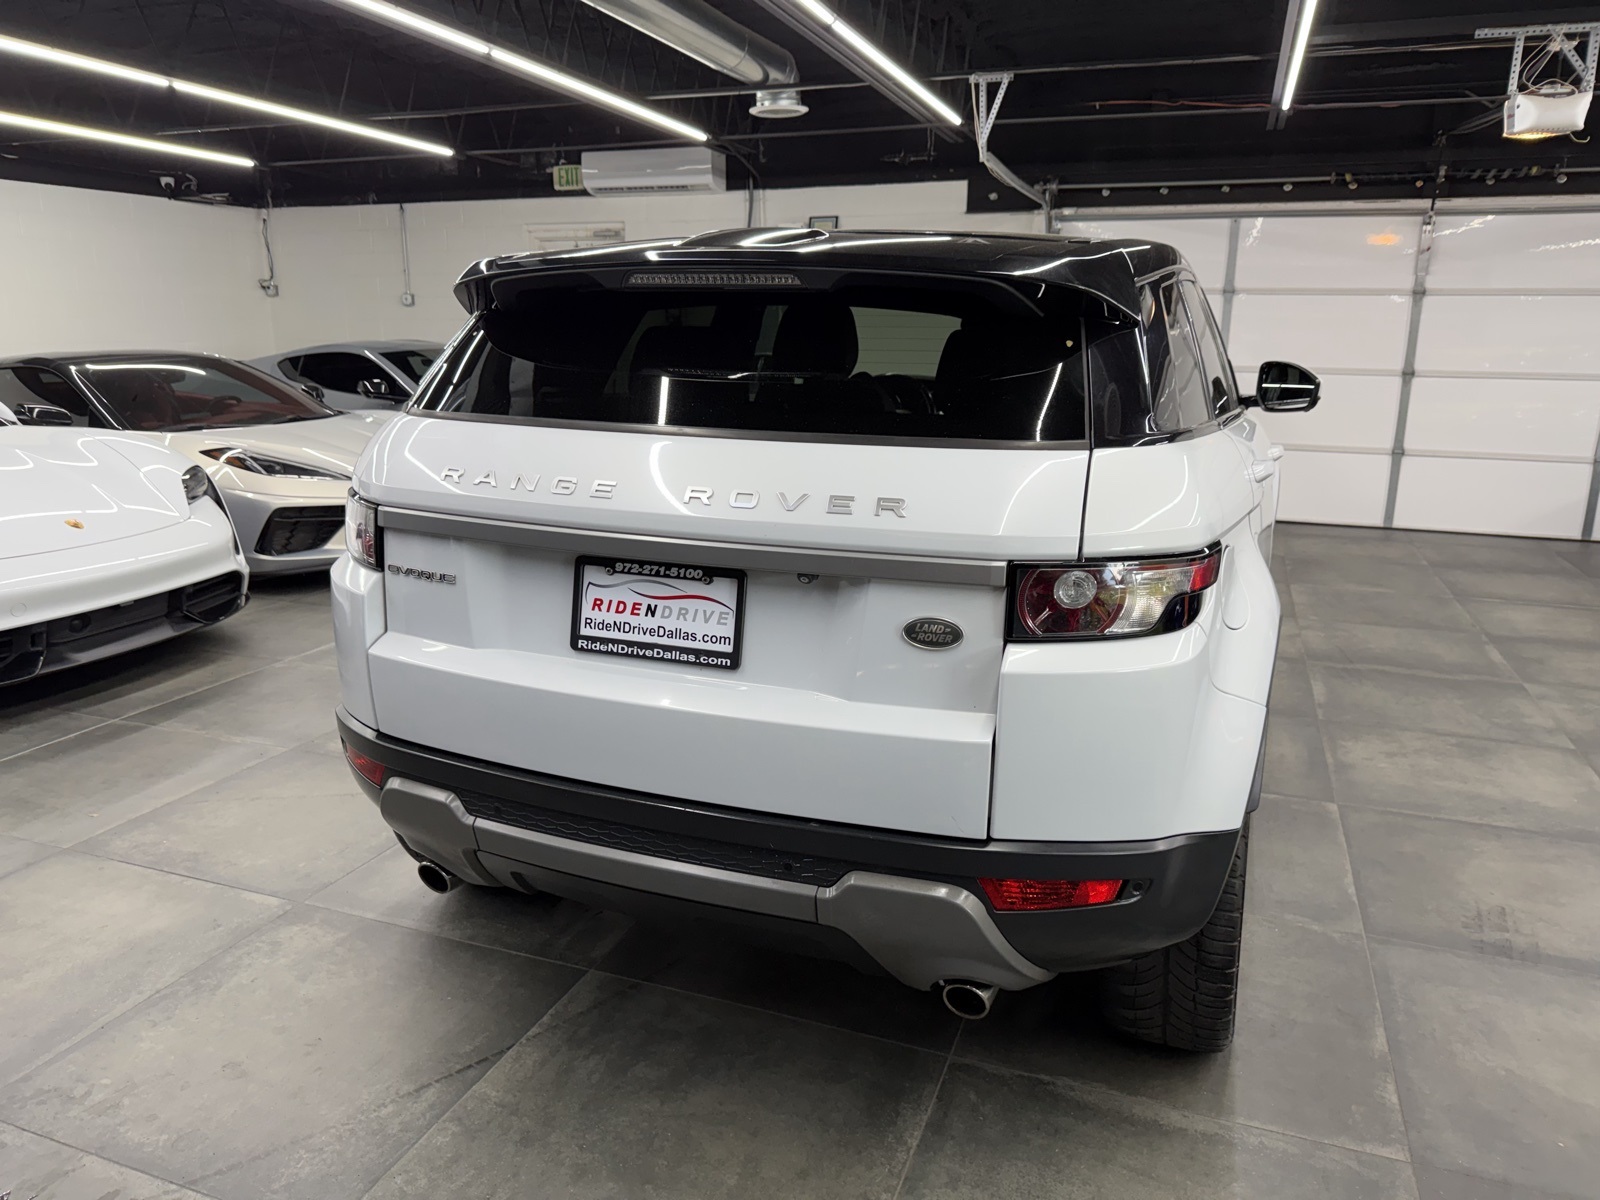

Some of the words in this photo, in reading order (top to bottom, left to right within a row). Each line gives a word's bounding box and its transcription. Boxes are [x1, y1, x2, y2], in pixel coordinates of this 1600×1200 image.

[558, 167, 579, 187] EXIT
[440, 465, 617, 499] RANGE
[683, 485, 907, 518] ROVER
[388, 564, 456, 585] EVOQUE
[615, 562, 703, 579] 972-271-5100
[584, 617, 731, 646] RideNDriveDallas.com
[915, 623, 945, 634] LAND
[917, 632, 953, 643] ROVER
[577, 639, 731, 666] RideNDriveDallas.com
